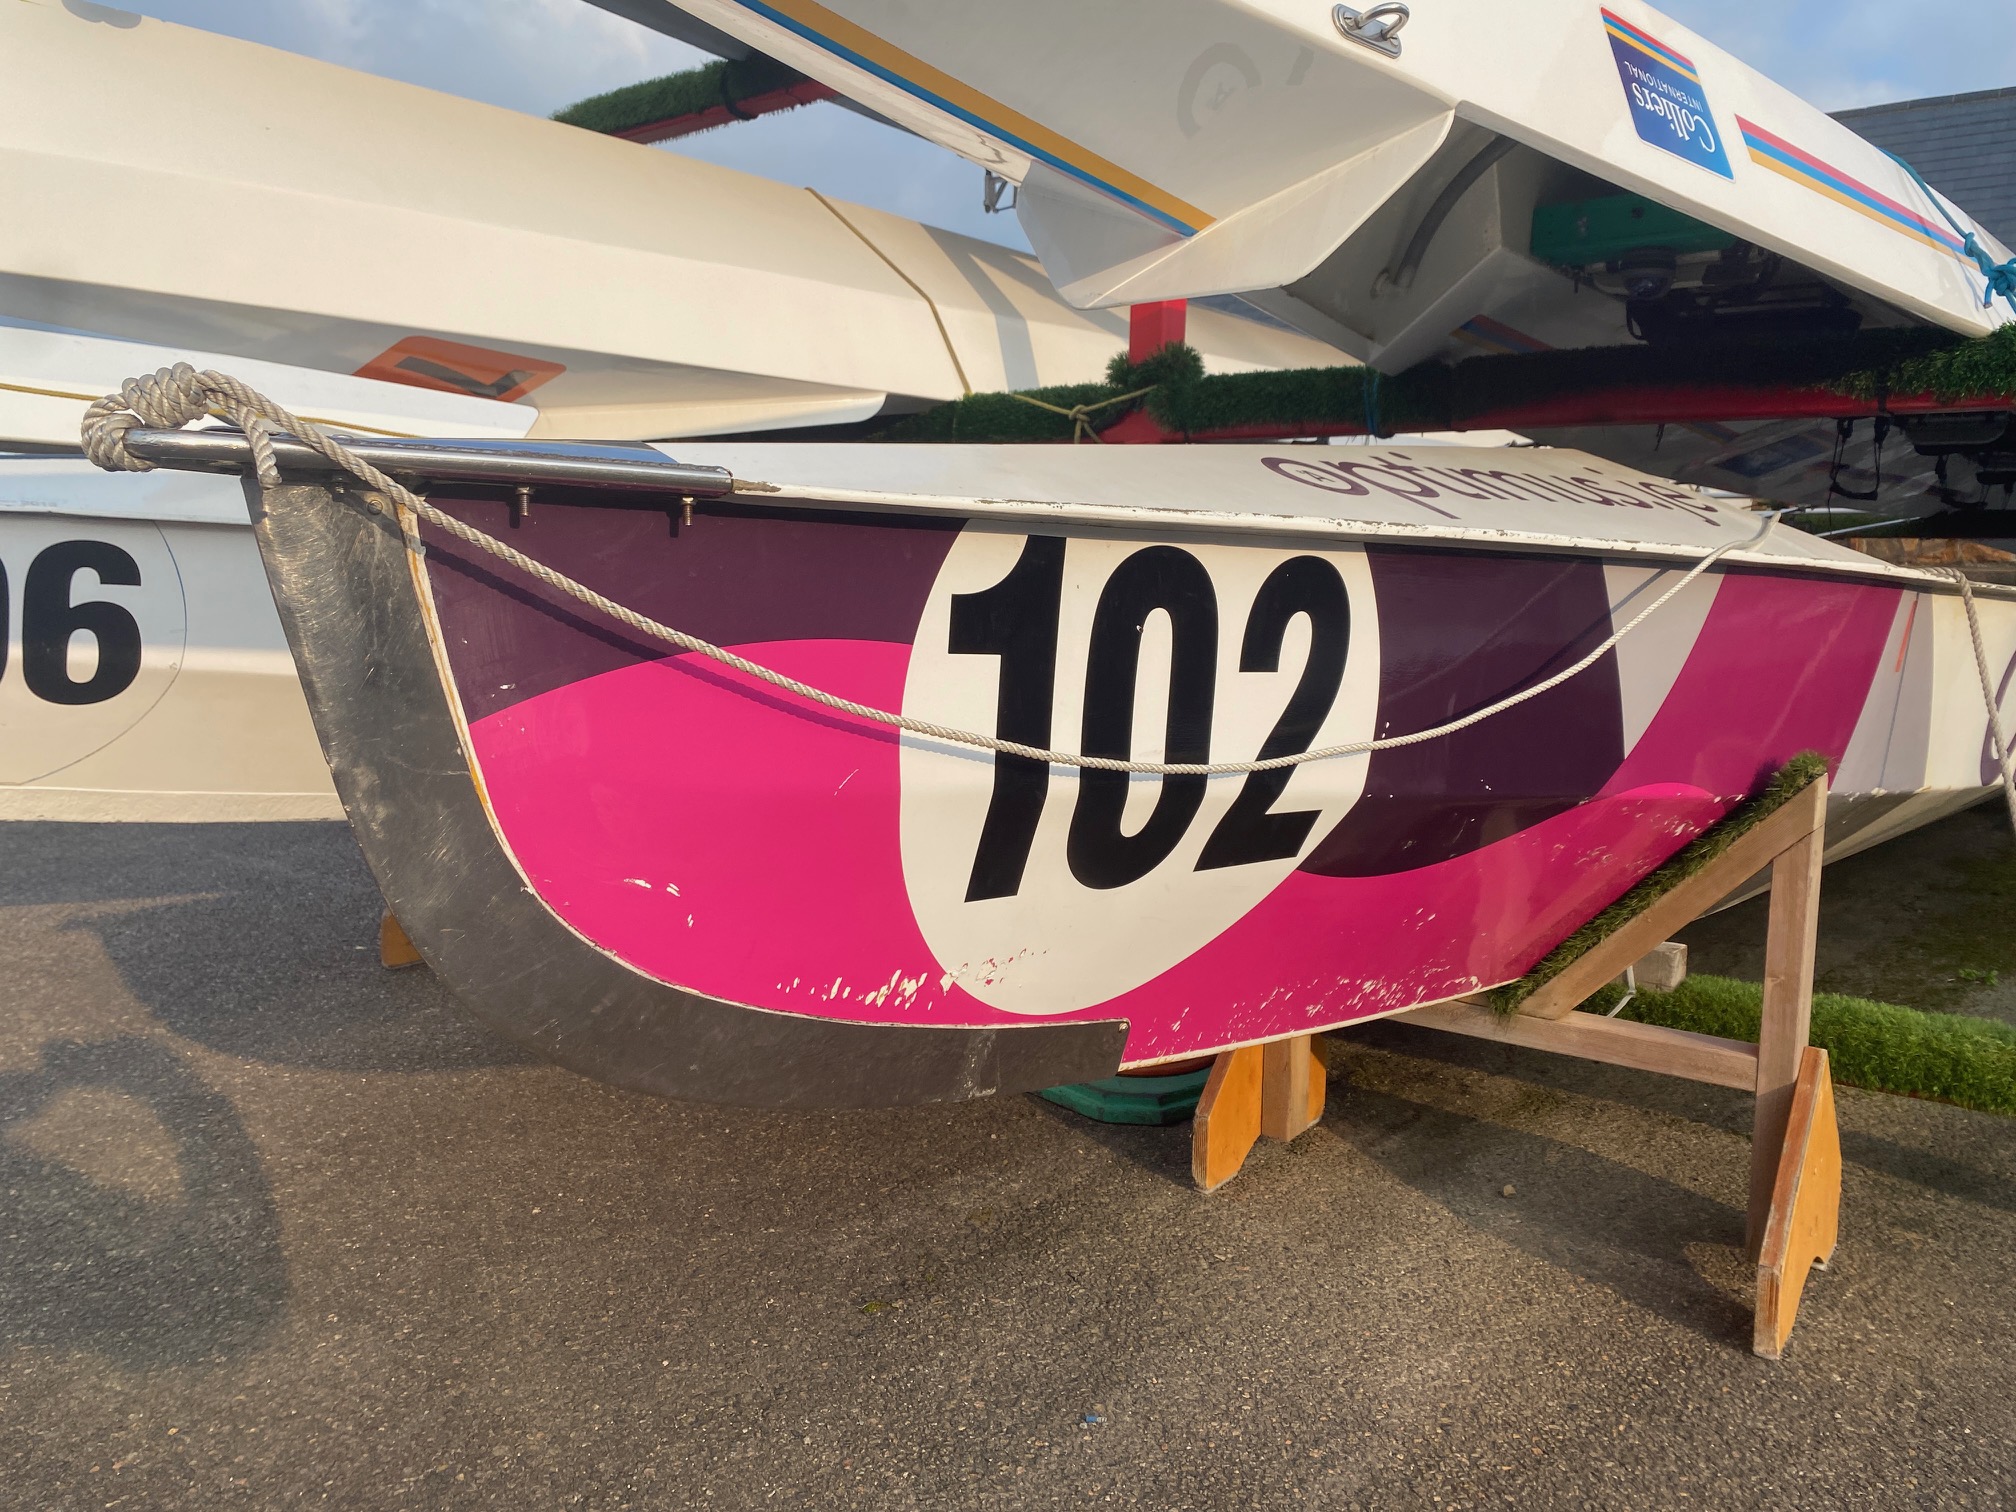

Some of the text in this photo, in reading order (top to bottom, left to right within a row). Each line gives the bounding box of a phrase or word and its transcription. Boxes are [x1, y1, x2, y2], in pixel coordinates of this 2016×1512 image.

[1624, 61, 1703, 112] INTERNATIONAL
[1632, 83, 1715, 152] Colliers
[0, 540, 142, 705] 6
[948, 534, 1351, 903] 102
